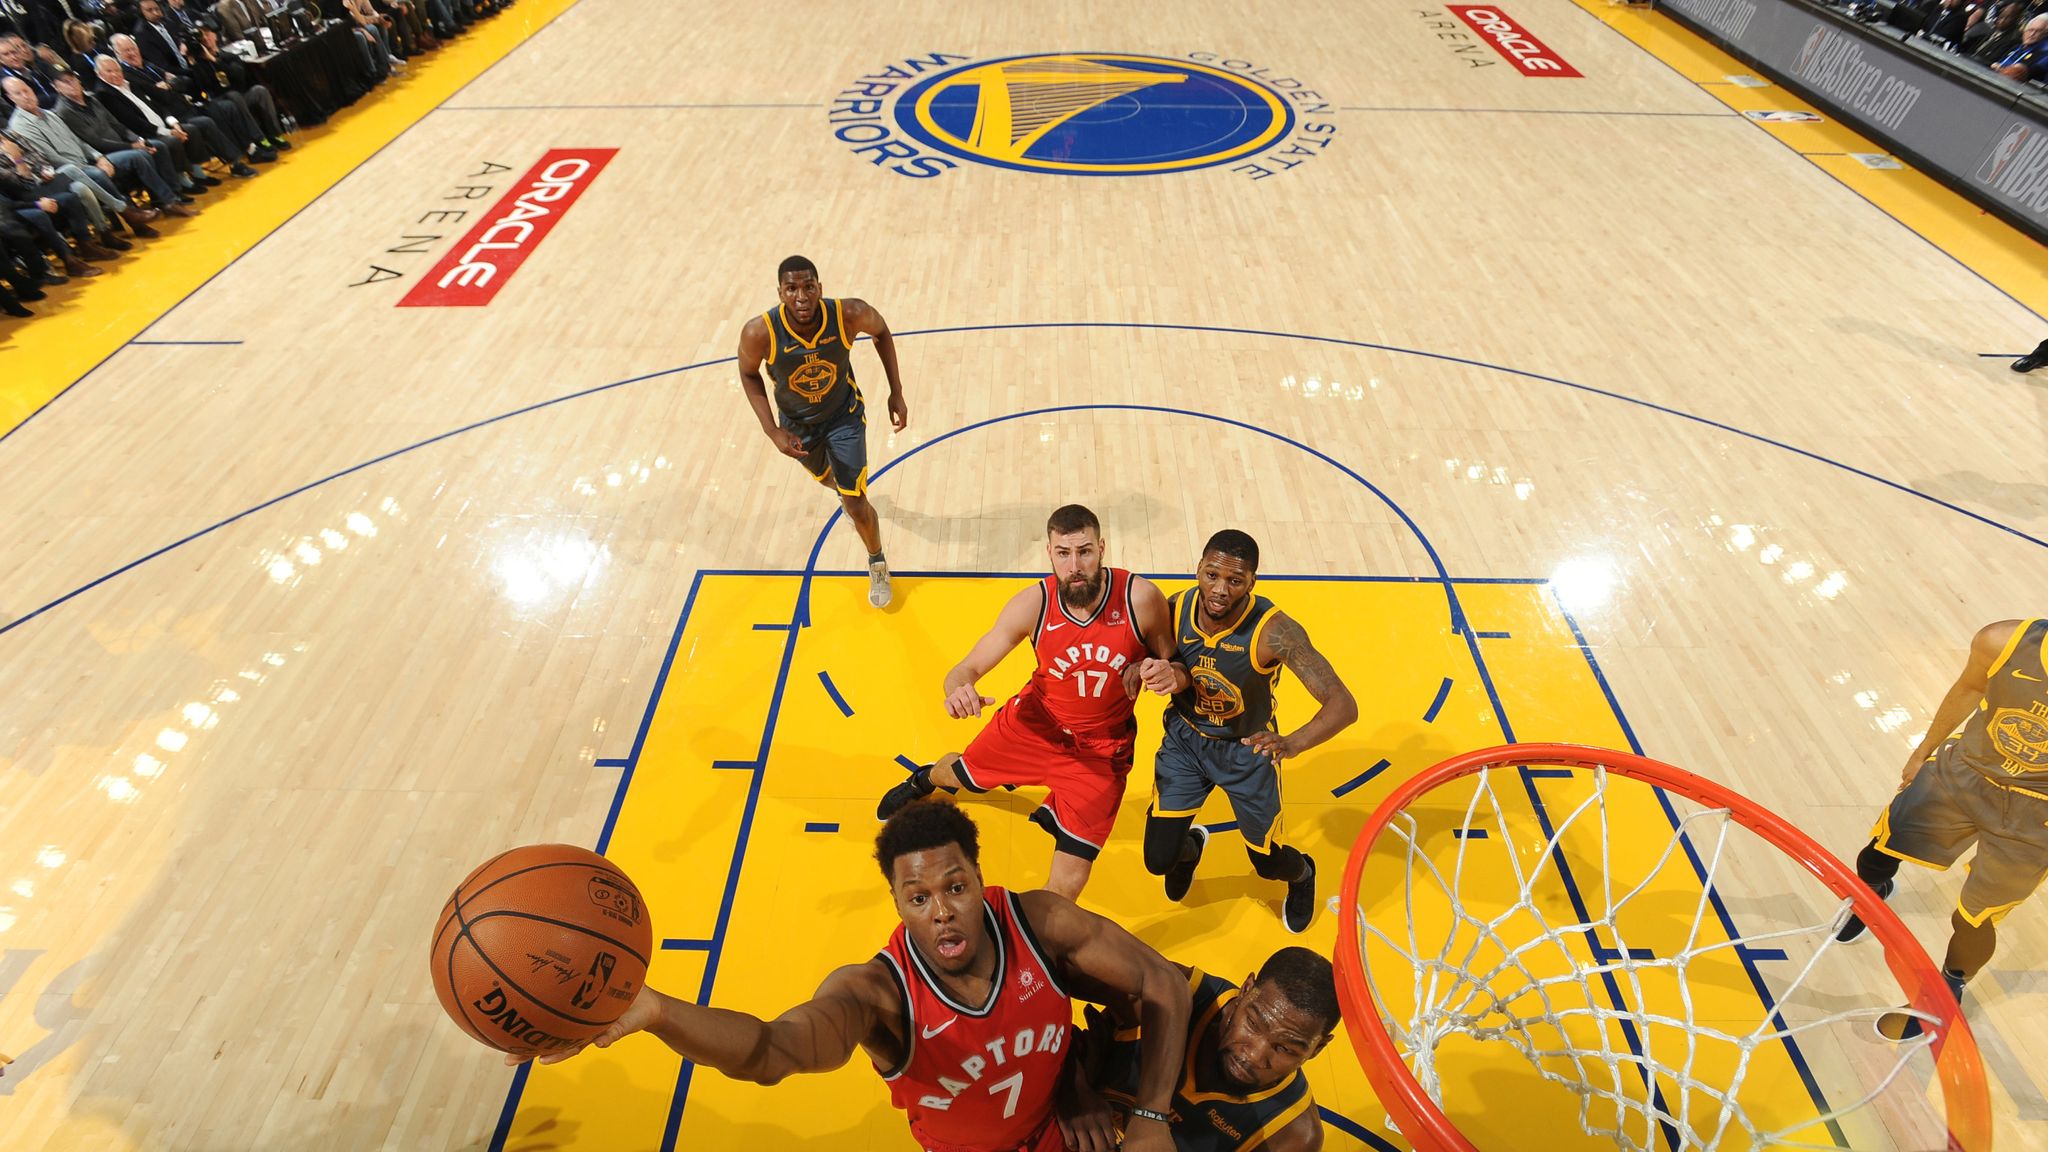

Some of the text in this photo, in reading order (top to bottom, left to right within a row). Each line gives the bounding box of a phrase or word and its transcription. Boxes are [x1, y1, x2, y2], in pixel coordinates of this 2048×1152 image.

[1413, 10, 1496, 69] ARENA
[1465, 9, 1562, 71] ORACLE
[1802, 30, 1921, 130] NBAStore.com
[828, 52, 972, 178] WARRIORS
[1188, 52, 1336, 180] GOLDEN STATE
[1993, 132, 2048, 213] NBA
[348, 161, 513, 288] ARENA
[437, 158, 591, 288] ORACLE
[803, 352, 820, 363] THE
[1048, 643, 1127, 680] APTOR
[1199, 655, 1217, 671] THE
[1220, 642, 1245, 652] Rakuten
[1072, 669, 1108, 697] 17
[1201, 697, 1225, 712] 28
[2029, 700, 2048, 719] TH
[2001, 758, 2026, 777] BAY
[1019, 980, 1045, 1003] Sun Life
[918, 1023, 1065, 1111] RAPTORS
[988, 1071, 1024, 1120] 7
[1208, 1109, 1242, 1141] Rakuten
